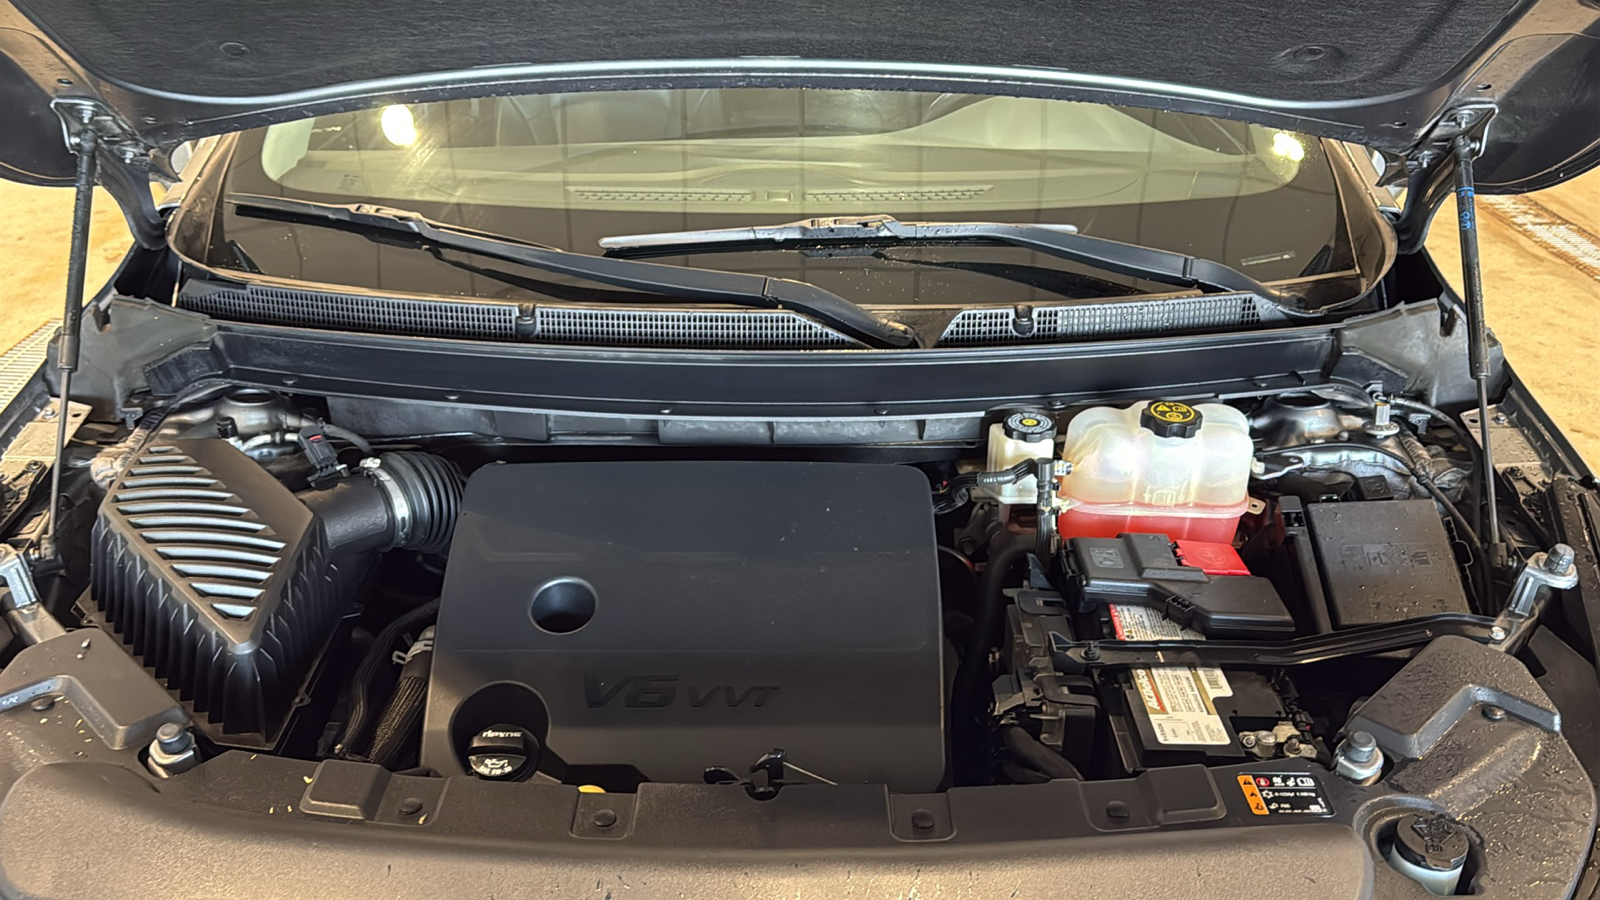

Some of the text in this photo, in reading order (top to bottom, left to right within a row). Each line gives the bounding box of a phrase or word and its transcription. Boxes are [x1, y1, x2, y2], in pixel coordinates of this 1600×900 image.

[583, 673, 781, 708] V6 VVT
[1136, 668, 1160, 711] ACDelco
